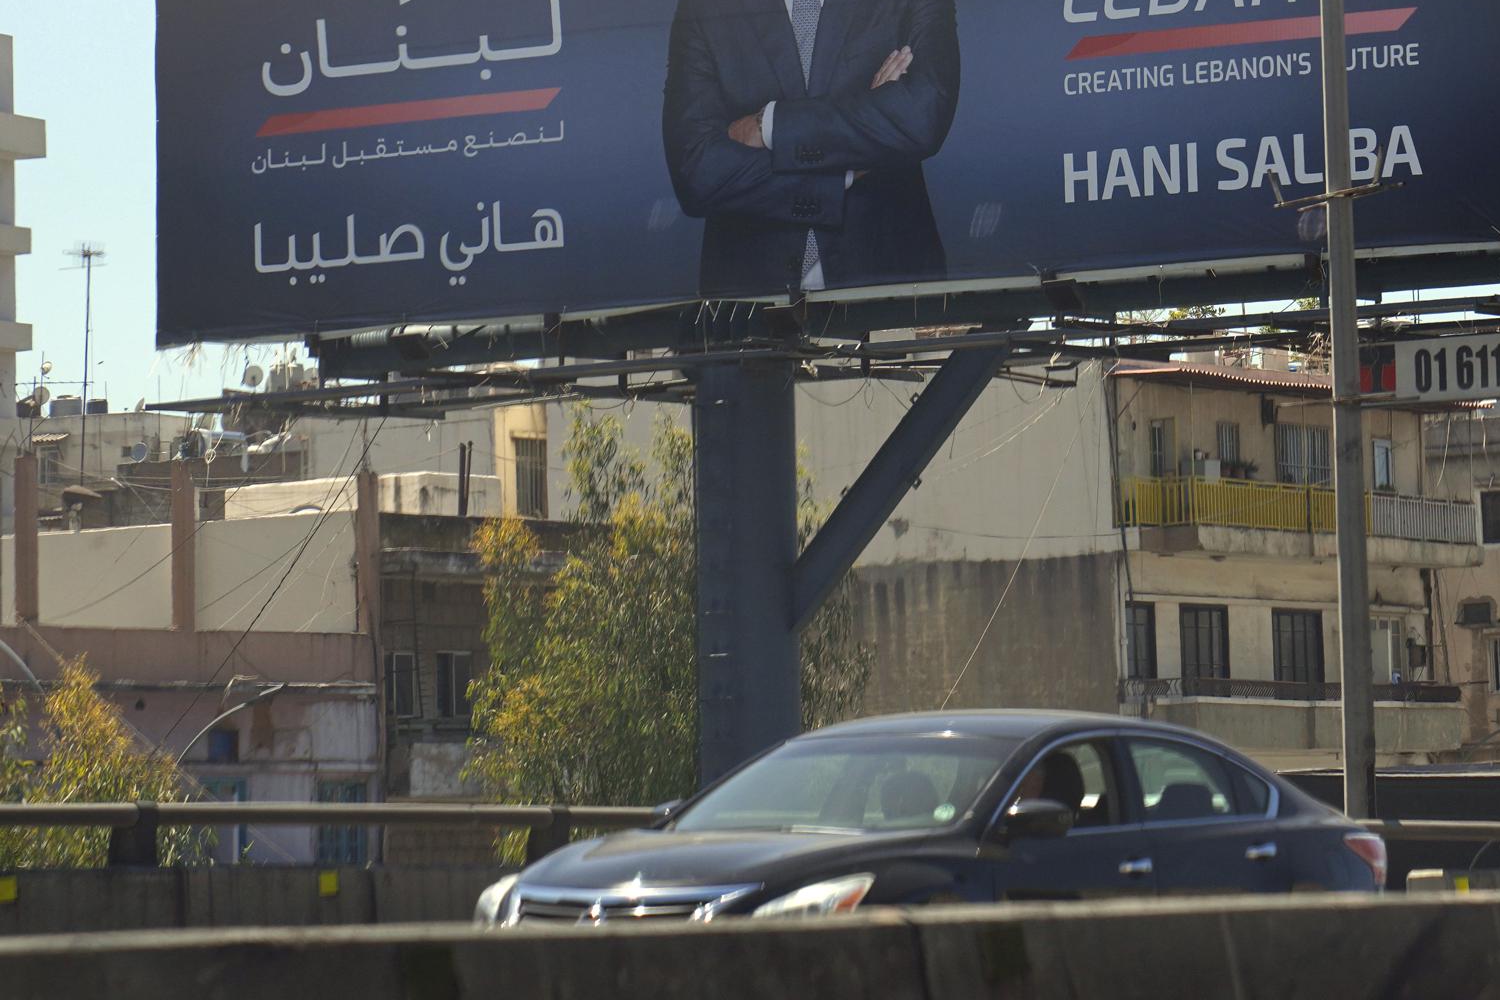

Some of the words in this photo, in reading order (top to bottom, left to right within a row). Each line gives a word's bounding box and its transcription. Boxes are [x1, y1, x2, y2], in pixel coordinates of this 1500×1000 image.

[1063, 64, 1174, 96] CREATING
[1182, 51, 1312, 86] LEBANON'S
[251, 143, 326, 174] لبنان
[332, 138, 457, 169] مستقبل
[464, 120, 565, 157] لنصنع
[1063, 142, 1199, 204] HANI
[1216, 125, 1424, 191] SALBA
[253, 214, 425, 286] صليبا
[439, 200, 564, 287] هاني
[1414, 346, 1448, 394] 01
